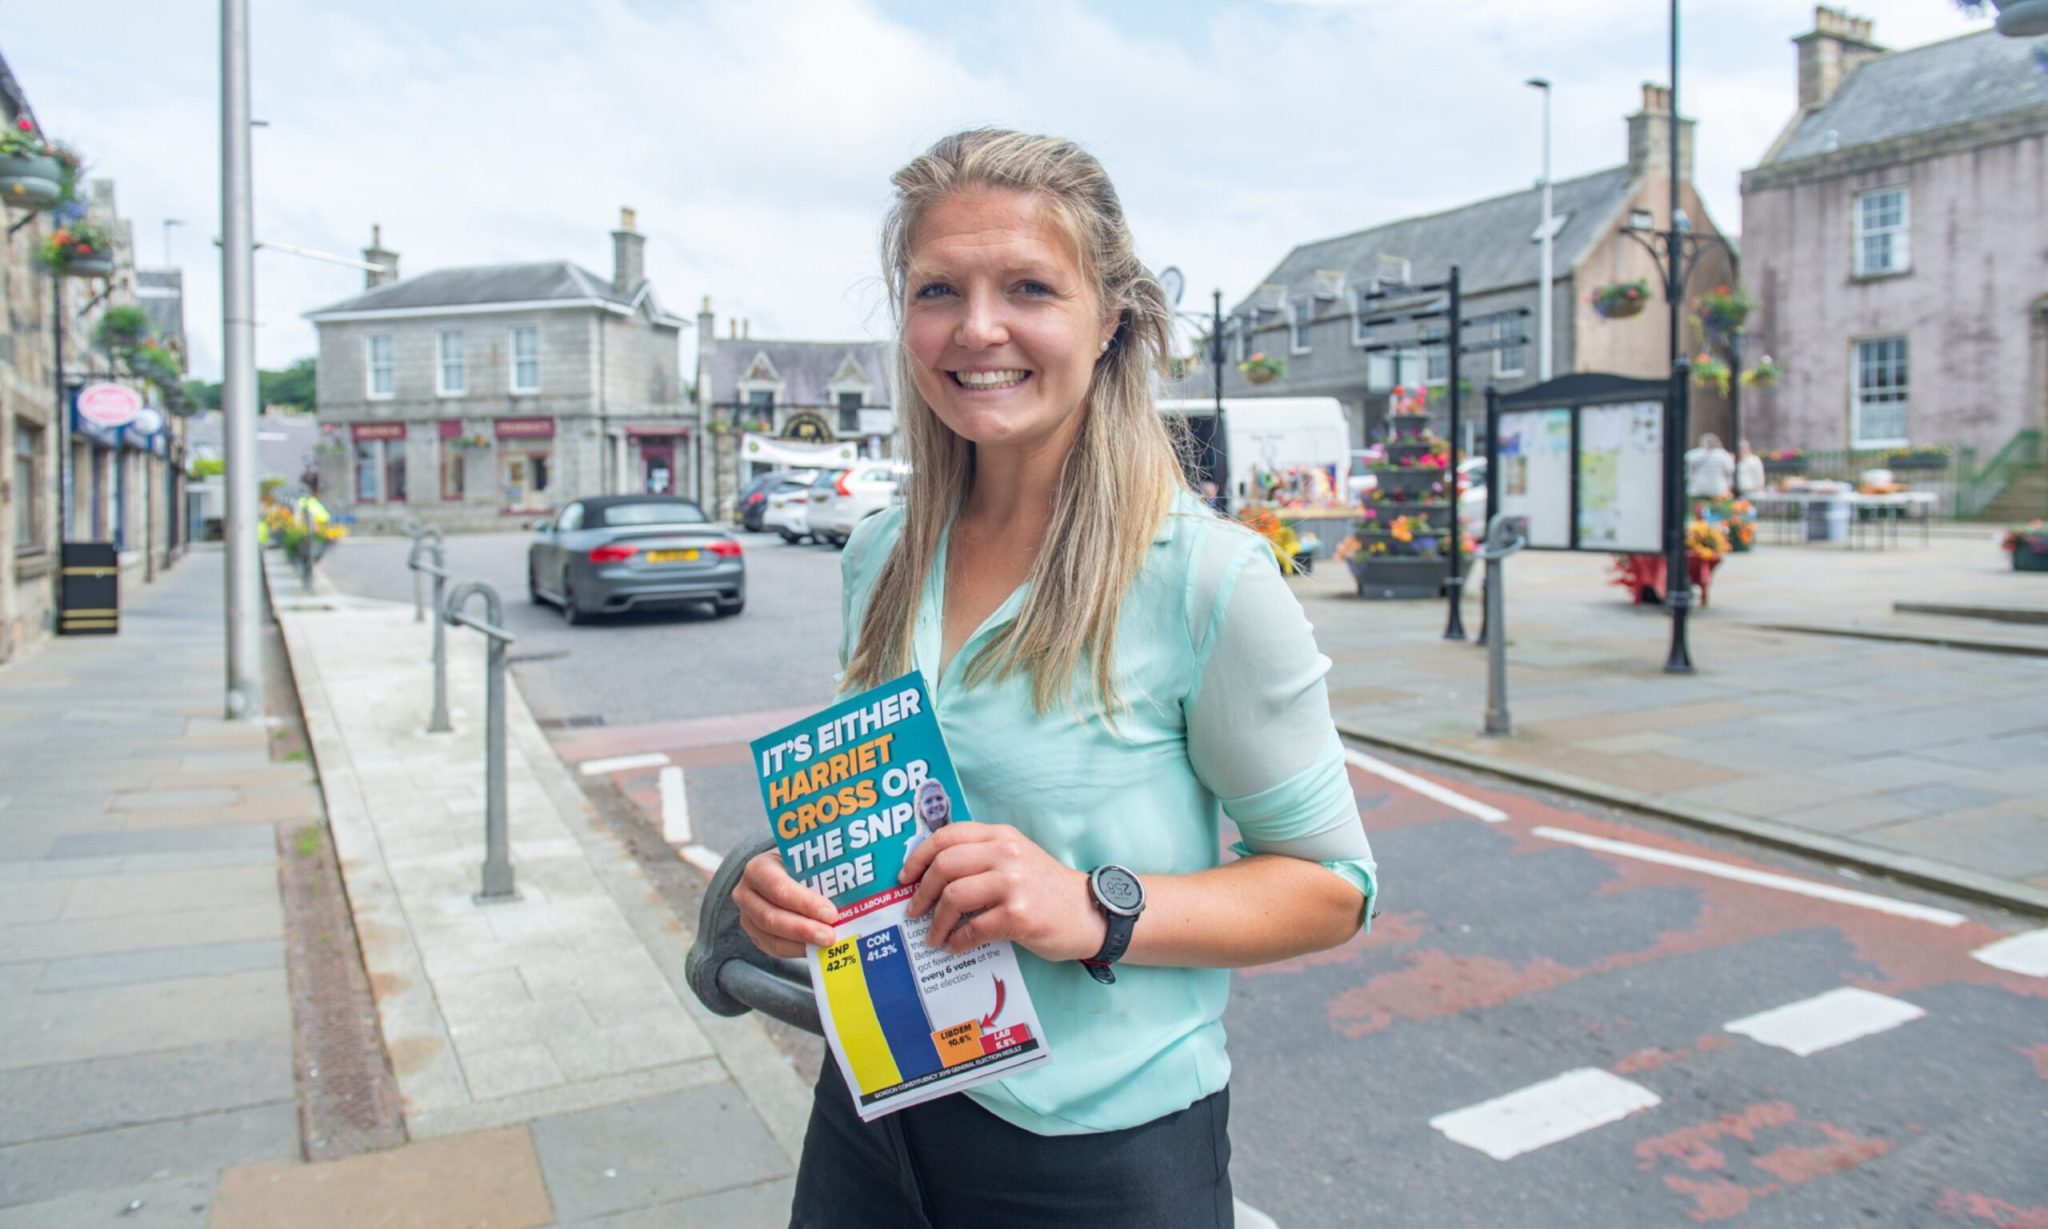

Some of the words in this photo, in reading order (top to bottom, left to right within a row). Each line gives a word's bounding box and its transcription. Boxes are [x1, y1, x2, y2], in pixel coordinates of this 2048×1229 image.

[762, 734, 813, 777] IT'S
[817, 687, 921, 753] EITHER
[769, 733, 894, 809] HARRIET
[778, 779, 878, 840] CROSS
[882, 759, 928, 798] OR
[788, 827, 844, 873] THE
[849, 802, 913, 849] SNP
[801, 853, 874, 899] HERE
[860, 894, 892, 911] LABOUR
[893, 885, 914, 899] JUST
[903, 917, 921, 928] The
[866, 931, 890, 948] CON
[907, 926, 930, 939] Labo
[828, 943, 850, 959] SNP
[867, 943, 898, 961] 41.3%
[827, 954, 857, 972] 42.7%
[917, 962, 932, 974] got
[932, 954, 955, 966] fewer
[921, 969, 945, 983] every
[946, 965, 952, 974] 6
[953, 958, 977, 971] votes
[977, 955, 986, 963] at
[986, 949, 1000, 959] the
[924, 983, 939, 994] last
[940, 972, 975, 989] election.
[941, 1024, 972, 1040] LIBDEM
[948, 1035, 972, 1047] 10.6%
[994, 1028, 1011, 1041] LAB
